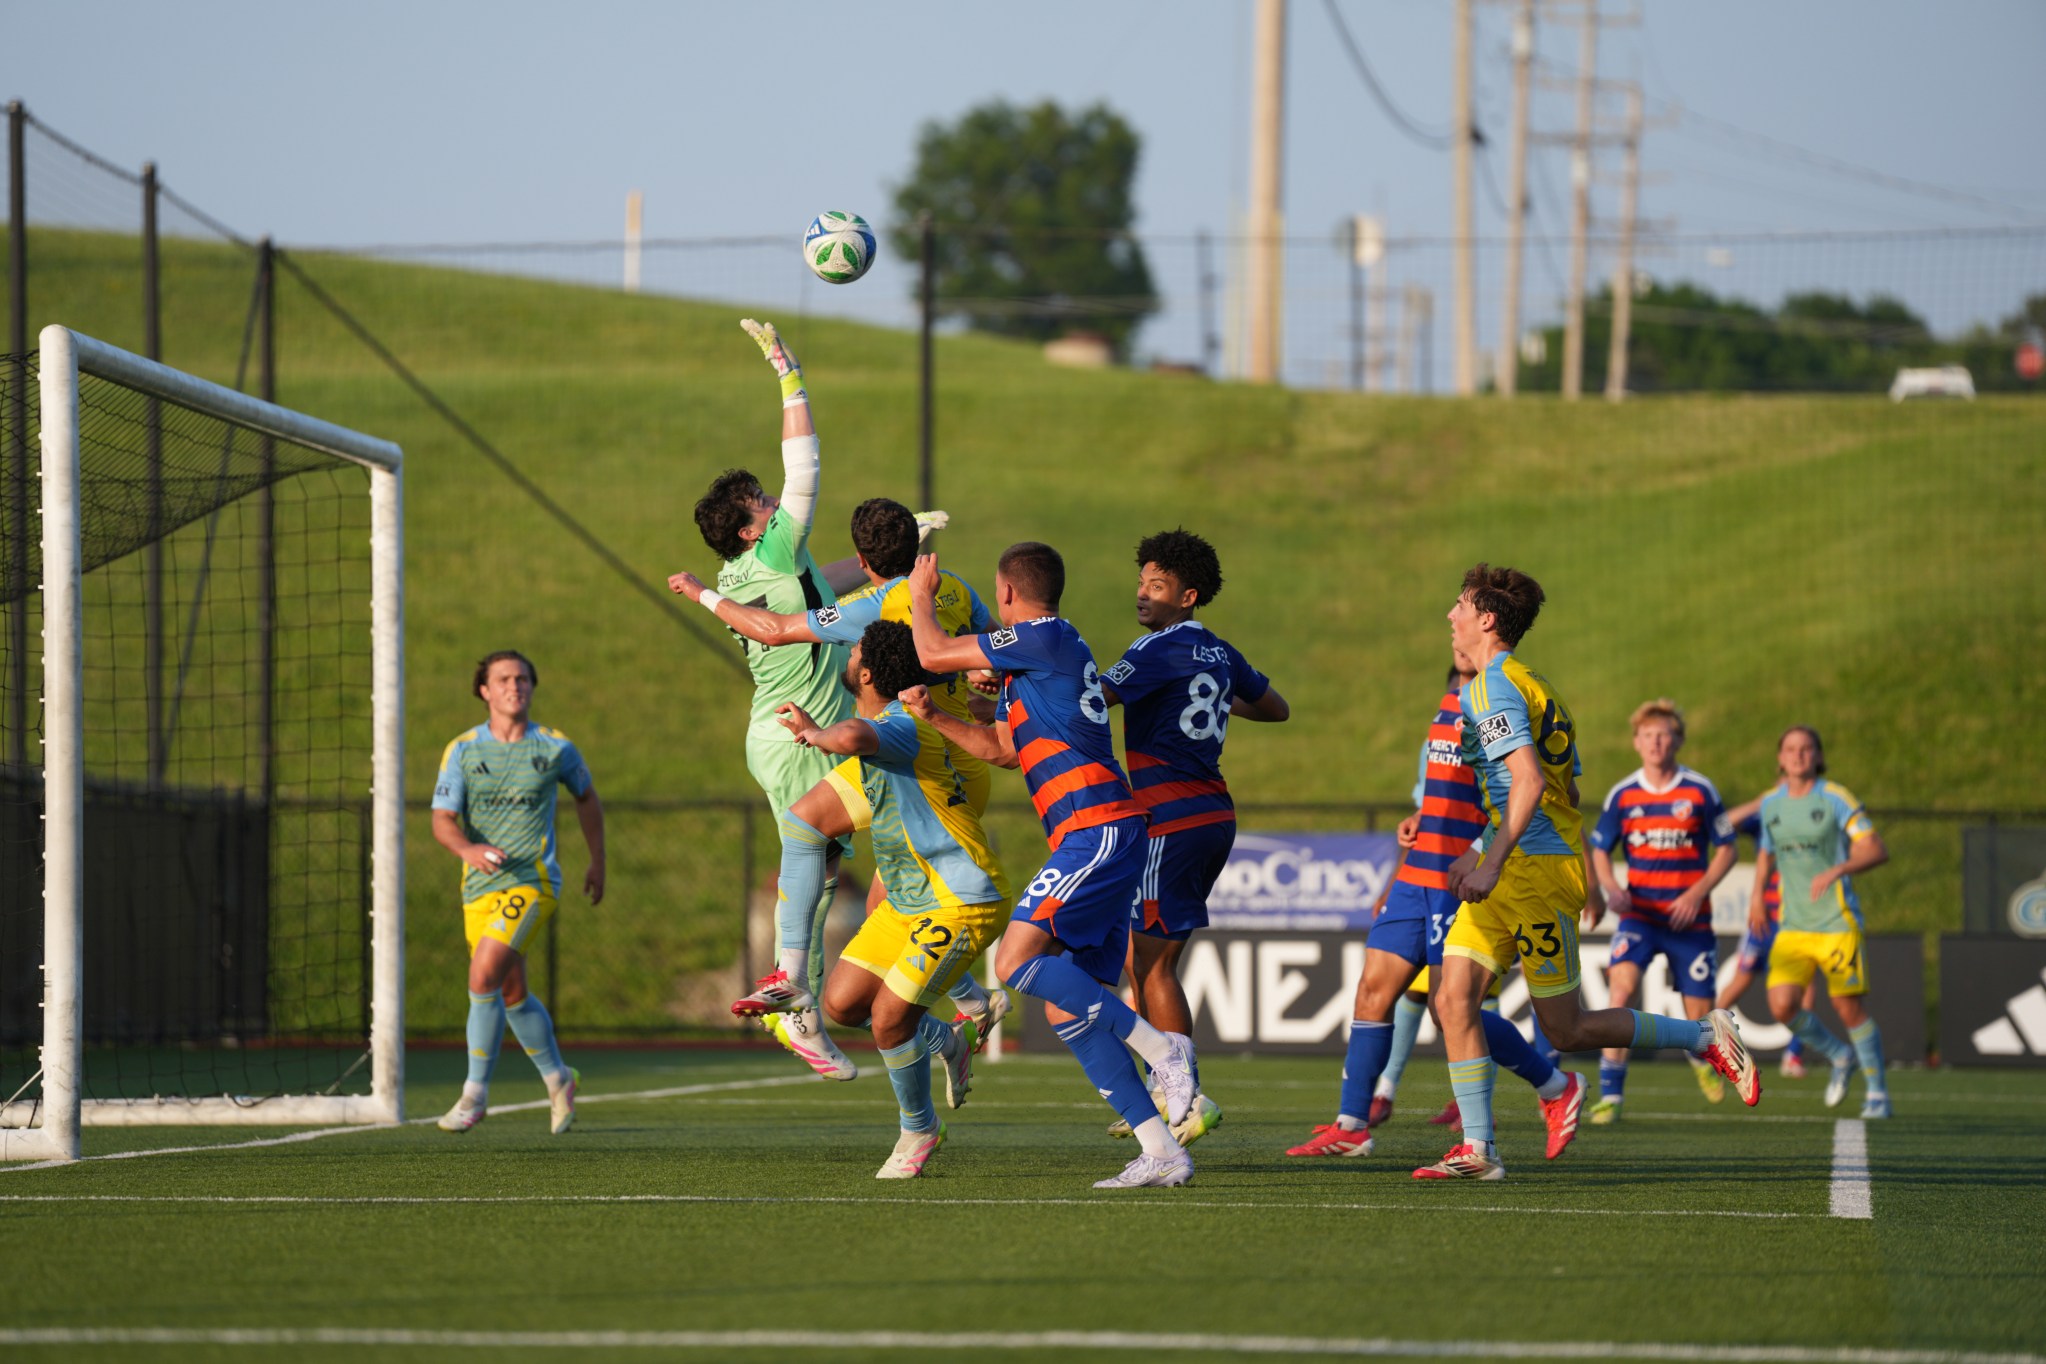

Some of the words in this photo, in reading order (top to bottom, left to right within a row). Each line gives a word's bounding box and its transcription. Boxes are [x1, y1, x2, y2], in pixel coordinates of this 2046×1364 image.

[1480, 715, 1504, 736] NEXT
[1487, 725, 1510, 742] PRO
[1431, 739, 1458, 753] MERCY
[1428, 751, 1463, 767] HEALTH
[1024, 868, 1061, 897] 8
[1513, 923, 1560, 957] 63
